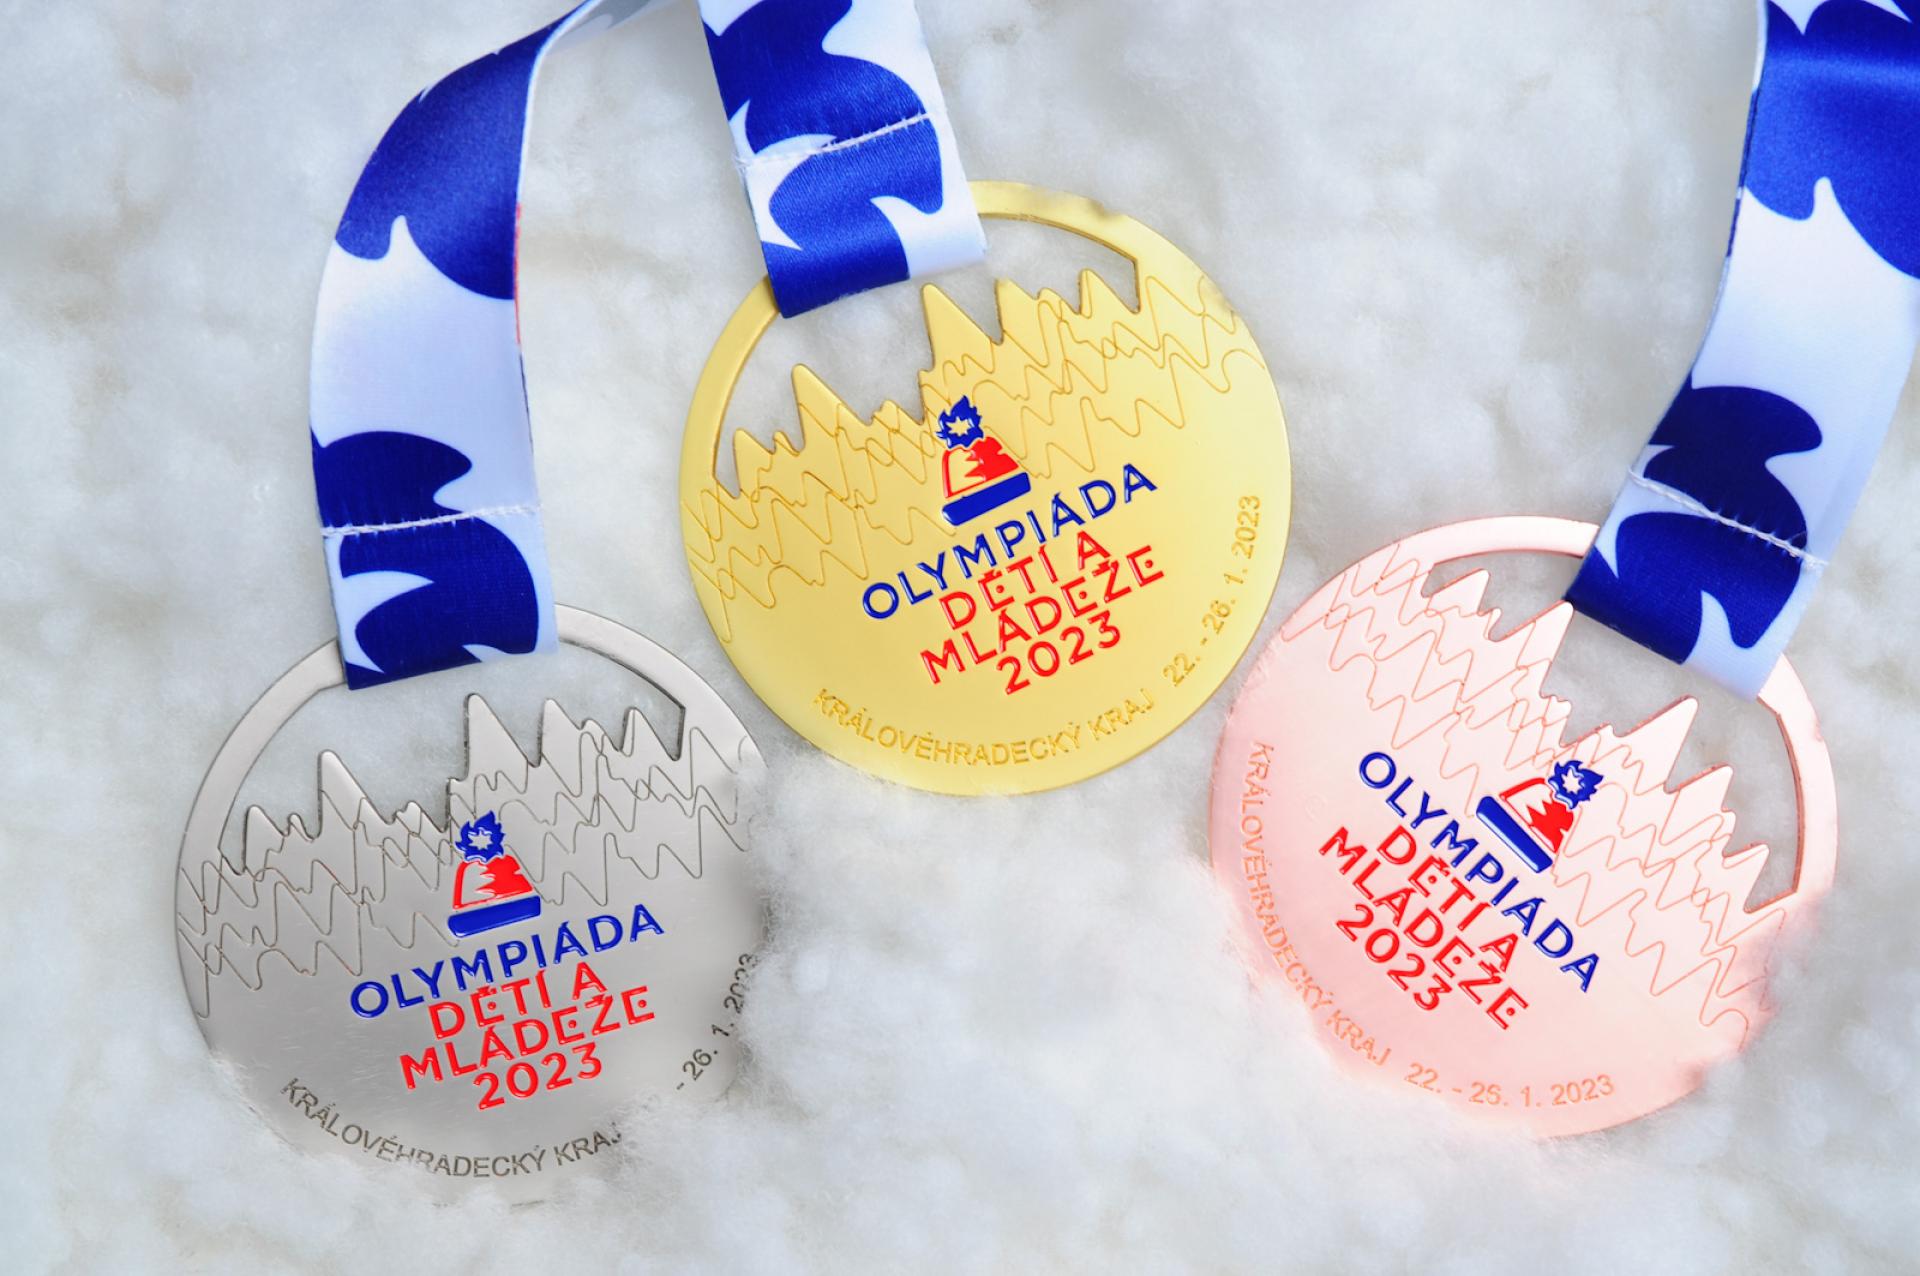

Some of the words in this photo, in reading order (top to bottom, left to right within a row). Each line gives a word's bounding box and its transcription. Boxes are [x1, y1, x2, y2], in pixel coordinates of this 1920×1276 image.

[863, 464, 1157, 620] OLYMPIÁDA
[1224, 549, 1248, 585] 1.
[1231, 495, 1261, 559] 2023
[920, 545, 1165, 686] MLÁDEŽE
[938, 545, 1059, 631] DĚTÍ
[1076, 530, 1111, 571] A
[1202, 599, 1236, 635] 26.
[997, 609, 1121, 696] 2023
[1163, 652, 1201, 686] 22.
[814, 688, 1081, 766] KRÁLOVÉHRADECKÝ
[1087, 688, 1156, 741] KRAJ
[1241, 740, 1334, 1011] KRÁLOVÉHRADECKÝ
[1326, 1010, 1392, 1066] KRAJ
[1359, 751, 1600, 992] OLYMPIÁDA
[1376, 824, 1491, 932] DĚTÍ
[1479, 932, 1519, 973] A
[350, 903, 665, 1019] OLYMPIÁDA
[1318, 826, 1529, 1031] MLÁDEŽE
[1335, 903, 1454, 1012] 2023
[399, 985, 655, 1090] MLÁDEŽE
[428, 969, 552, 1041] DĚTÍ
[572, 961, 607, 1001] A
[473, 1041, 603, 1111] 2023
[682, 1049, 718, 1081] 26.
[711, 1022, 735, 1037] 1.
[1404, 1062, 1442, 1093] 22.
[1520, 1086, 1542, 1107] 1.
[1551, 1074, 1615, 1106] 2023
